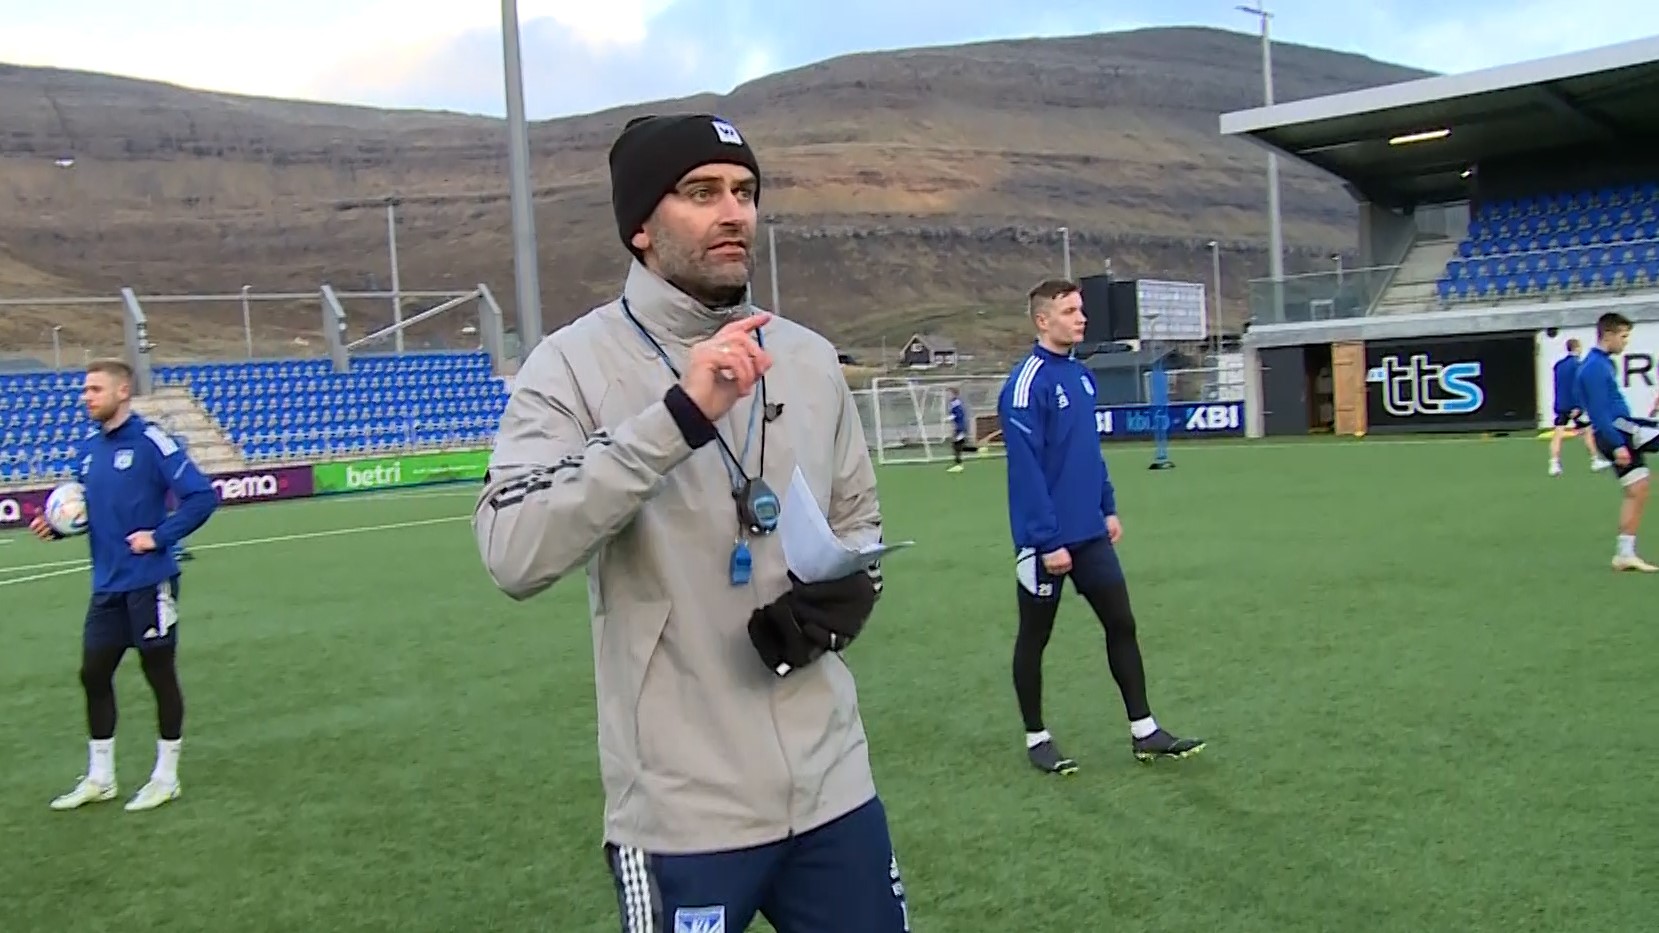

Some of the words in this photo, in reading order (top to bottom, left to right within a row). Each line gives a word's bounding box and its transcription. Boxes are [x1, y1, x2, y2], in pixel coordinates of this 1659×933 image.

[1382, 354, 1484, 416] tts
[1186, 404, 1239, 430] KBI
[346, 462, 400, 488] betri
